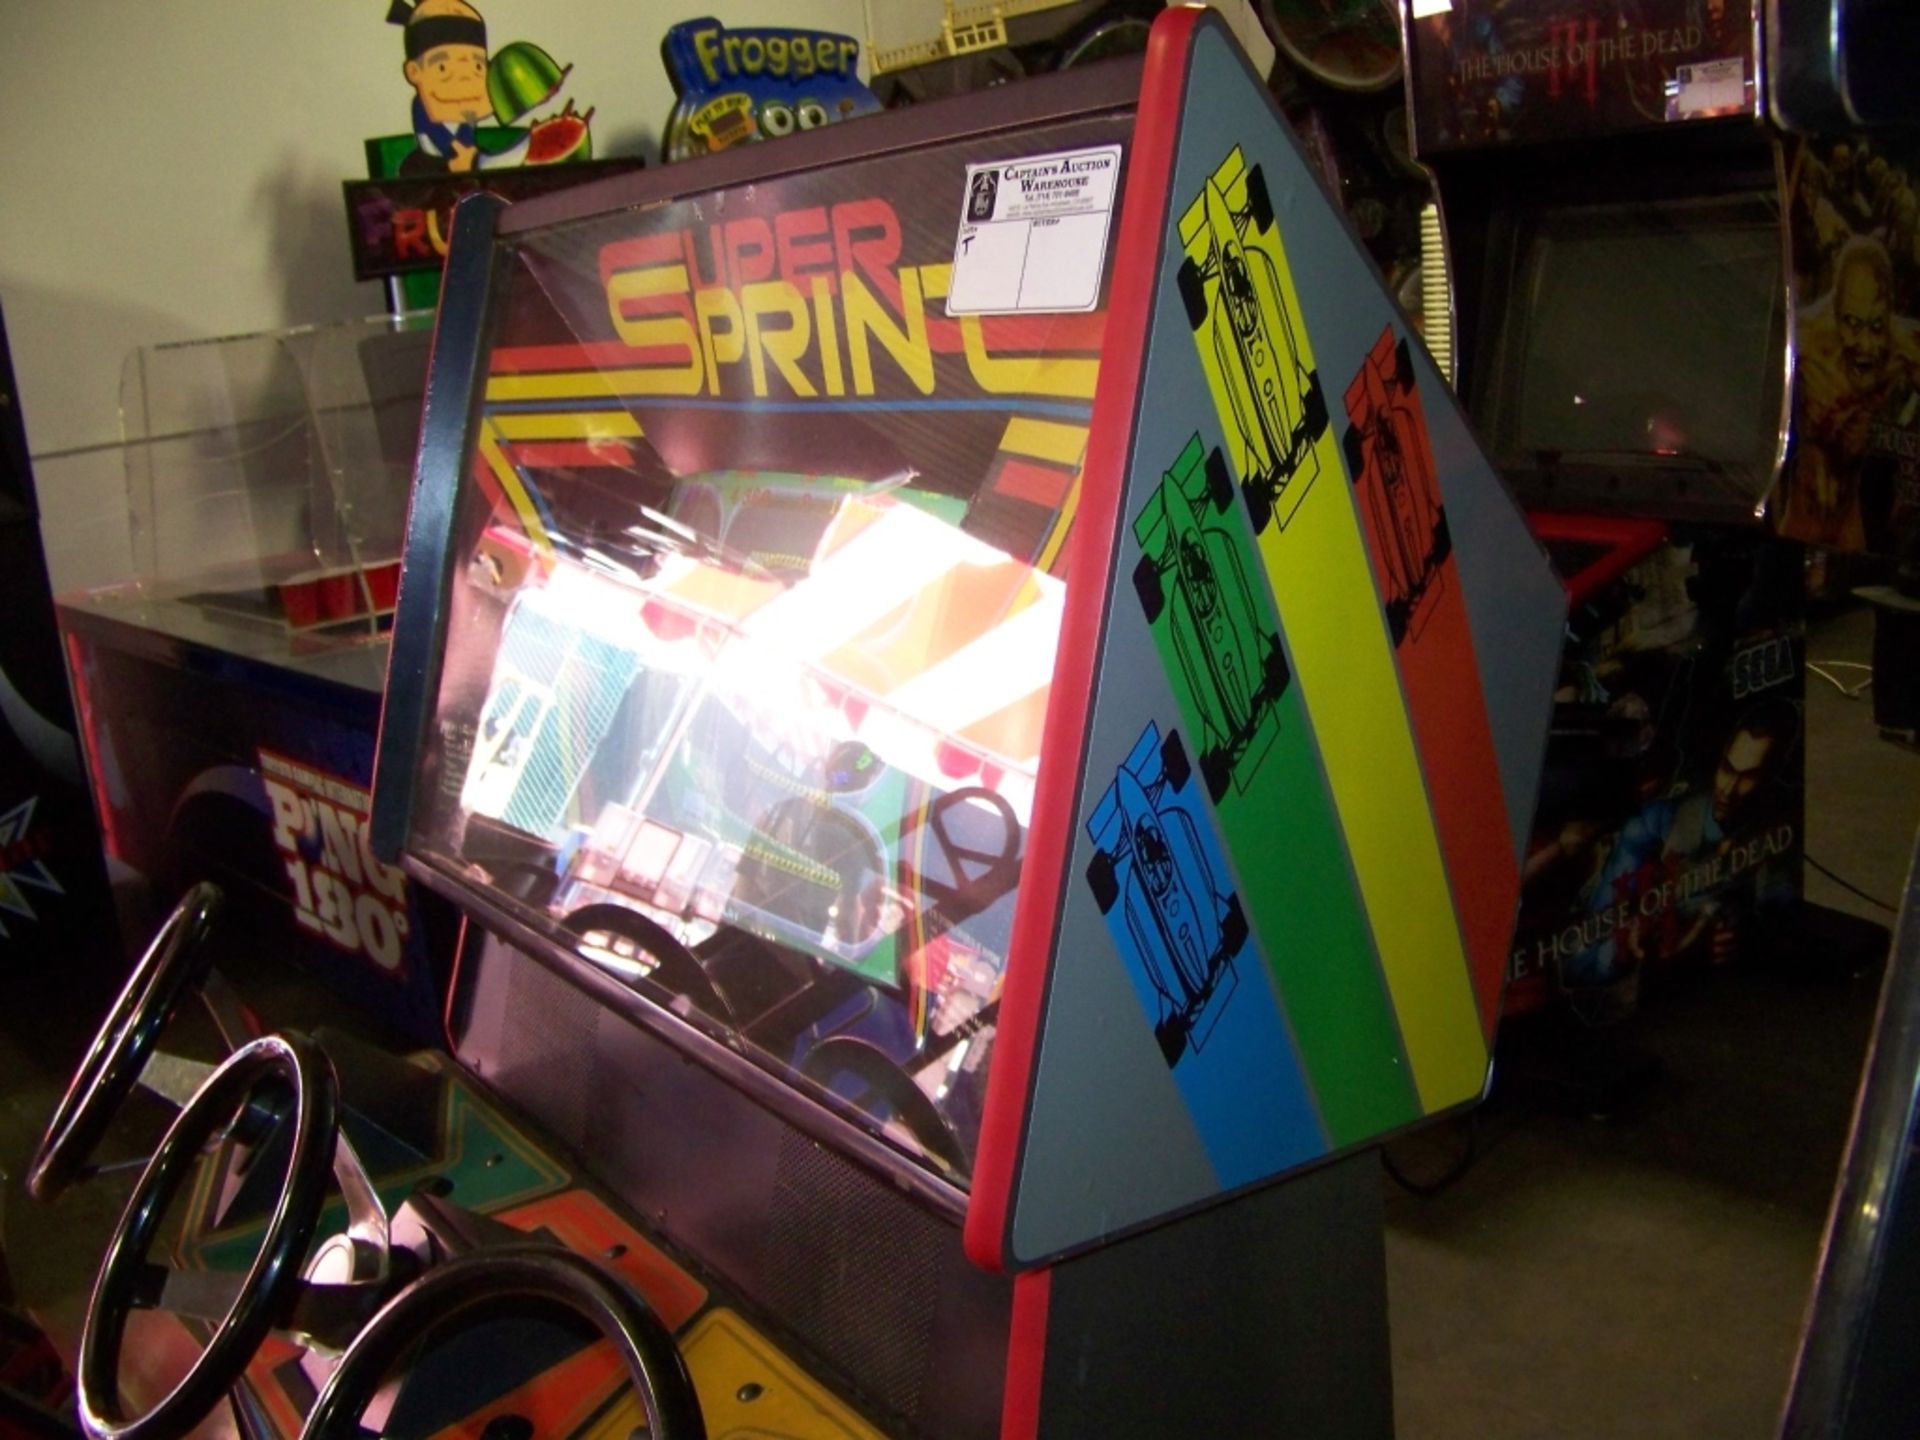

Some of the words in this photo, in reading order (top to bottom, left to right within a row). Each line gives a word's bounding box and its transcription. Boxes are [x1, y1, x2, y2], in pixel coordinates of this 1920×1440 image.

[693, 28, 857, 86] Frogger
[1458, 57, 1491, 84] THE
[1494, 46, 1562, 76] HOUSE
[1599, 35, 1637, 66] THE
[1642, 26, 1703, 57] DEAD
[1060, 159, 1111, 174] AUCTION
[598, 196, 902, 312] SUPER
[1733, 636, 1794, 699] SEGA
[1537, 897, 1630, 969] HOUSE
[1639, 879, 1674, 917] OF
[1679, 851, 1724, 900] THE
[1730, 825, 1793, 874] DEAD
